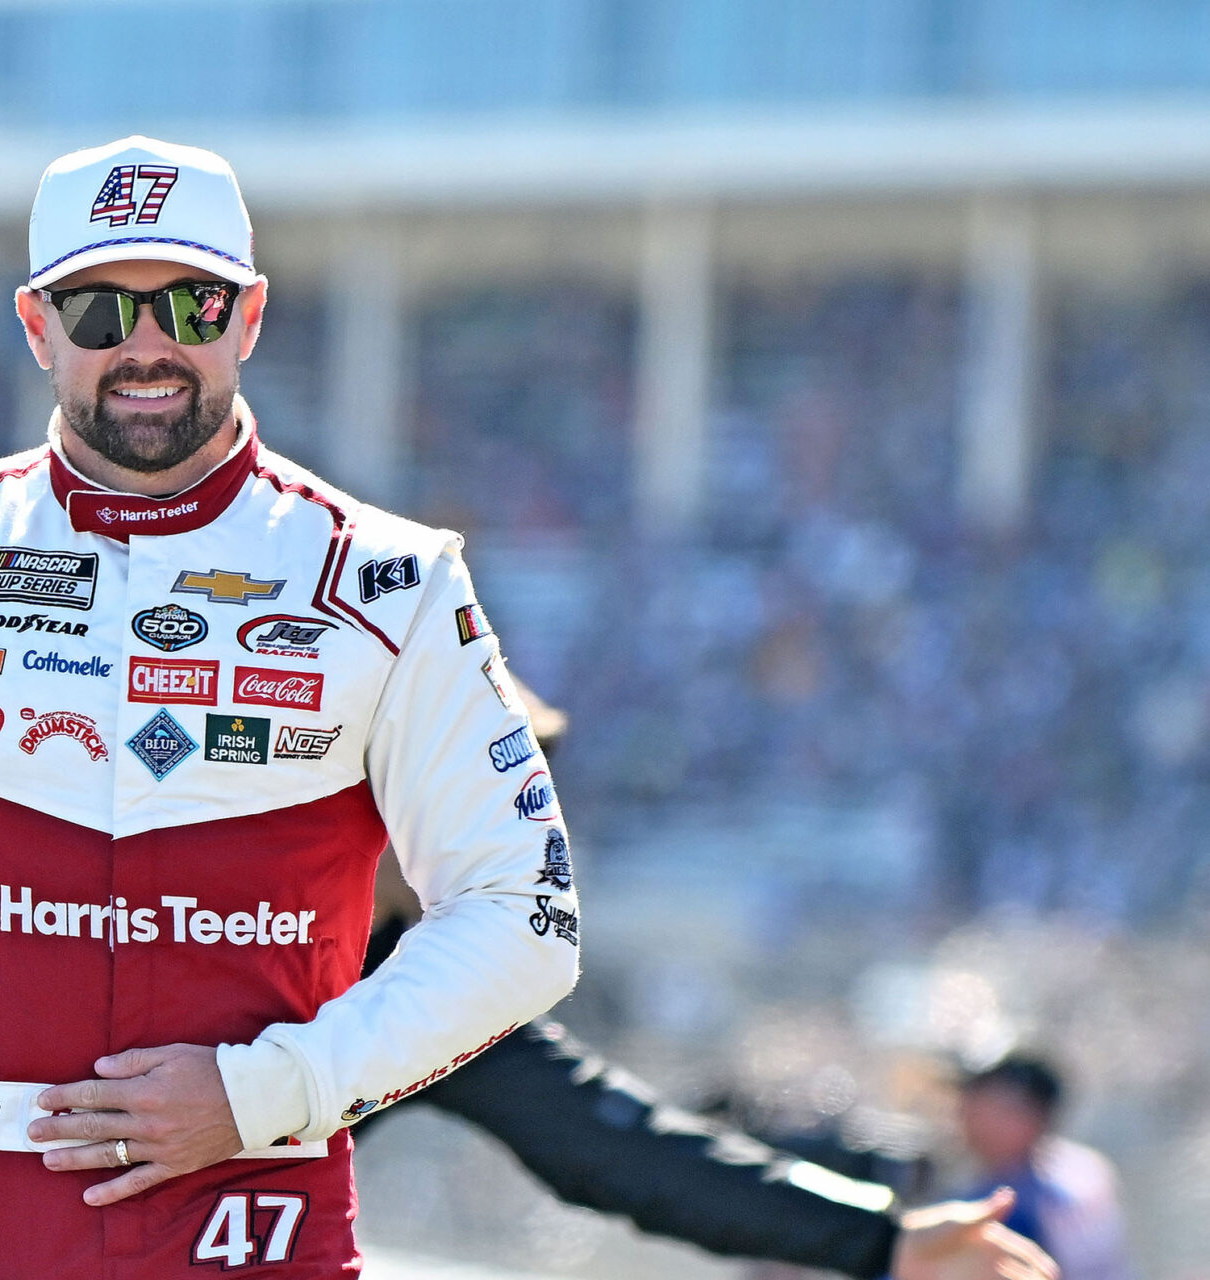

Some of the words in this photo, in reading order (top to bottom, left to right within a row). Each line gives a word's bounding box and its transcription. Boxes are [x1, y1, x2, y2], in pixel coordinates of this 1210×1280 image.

[90, 165, 178, 227] 47
[120, 509, 158, 521] Harris
[158, 501, 199, 519] Teeter
[15, 553, 81, 574] NASCAR
[21, 578, 78, 594] SERIES
[358, 554, 420, 604] K1
[142, 619, 199, 635] 500
[148, 632, 192, 640] CHAMPION
[23, 649, 111, 677] Cottonelle
[256, 648, 320, 660] RACING
[239, 674, 320, 703] Coca-Cola
[20, 717, 107, 760] DRUMSTICK
[145, 738, 179, 751] BLUE
[218, 734, 256, 749] IRISH
[274, 725, 342, 755] NOS
[210, 748, 261, 763] SPRING
[0, 884, 159, 944] Harris
[161, 895, 316, 946] Teeter
[381, 1066, 448, 1105] Harris
[193, 1191, 308, 1270] 47
